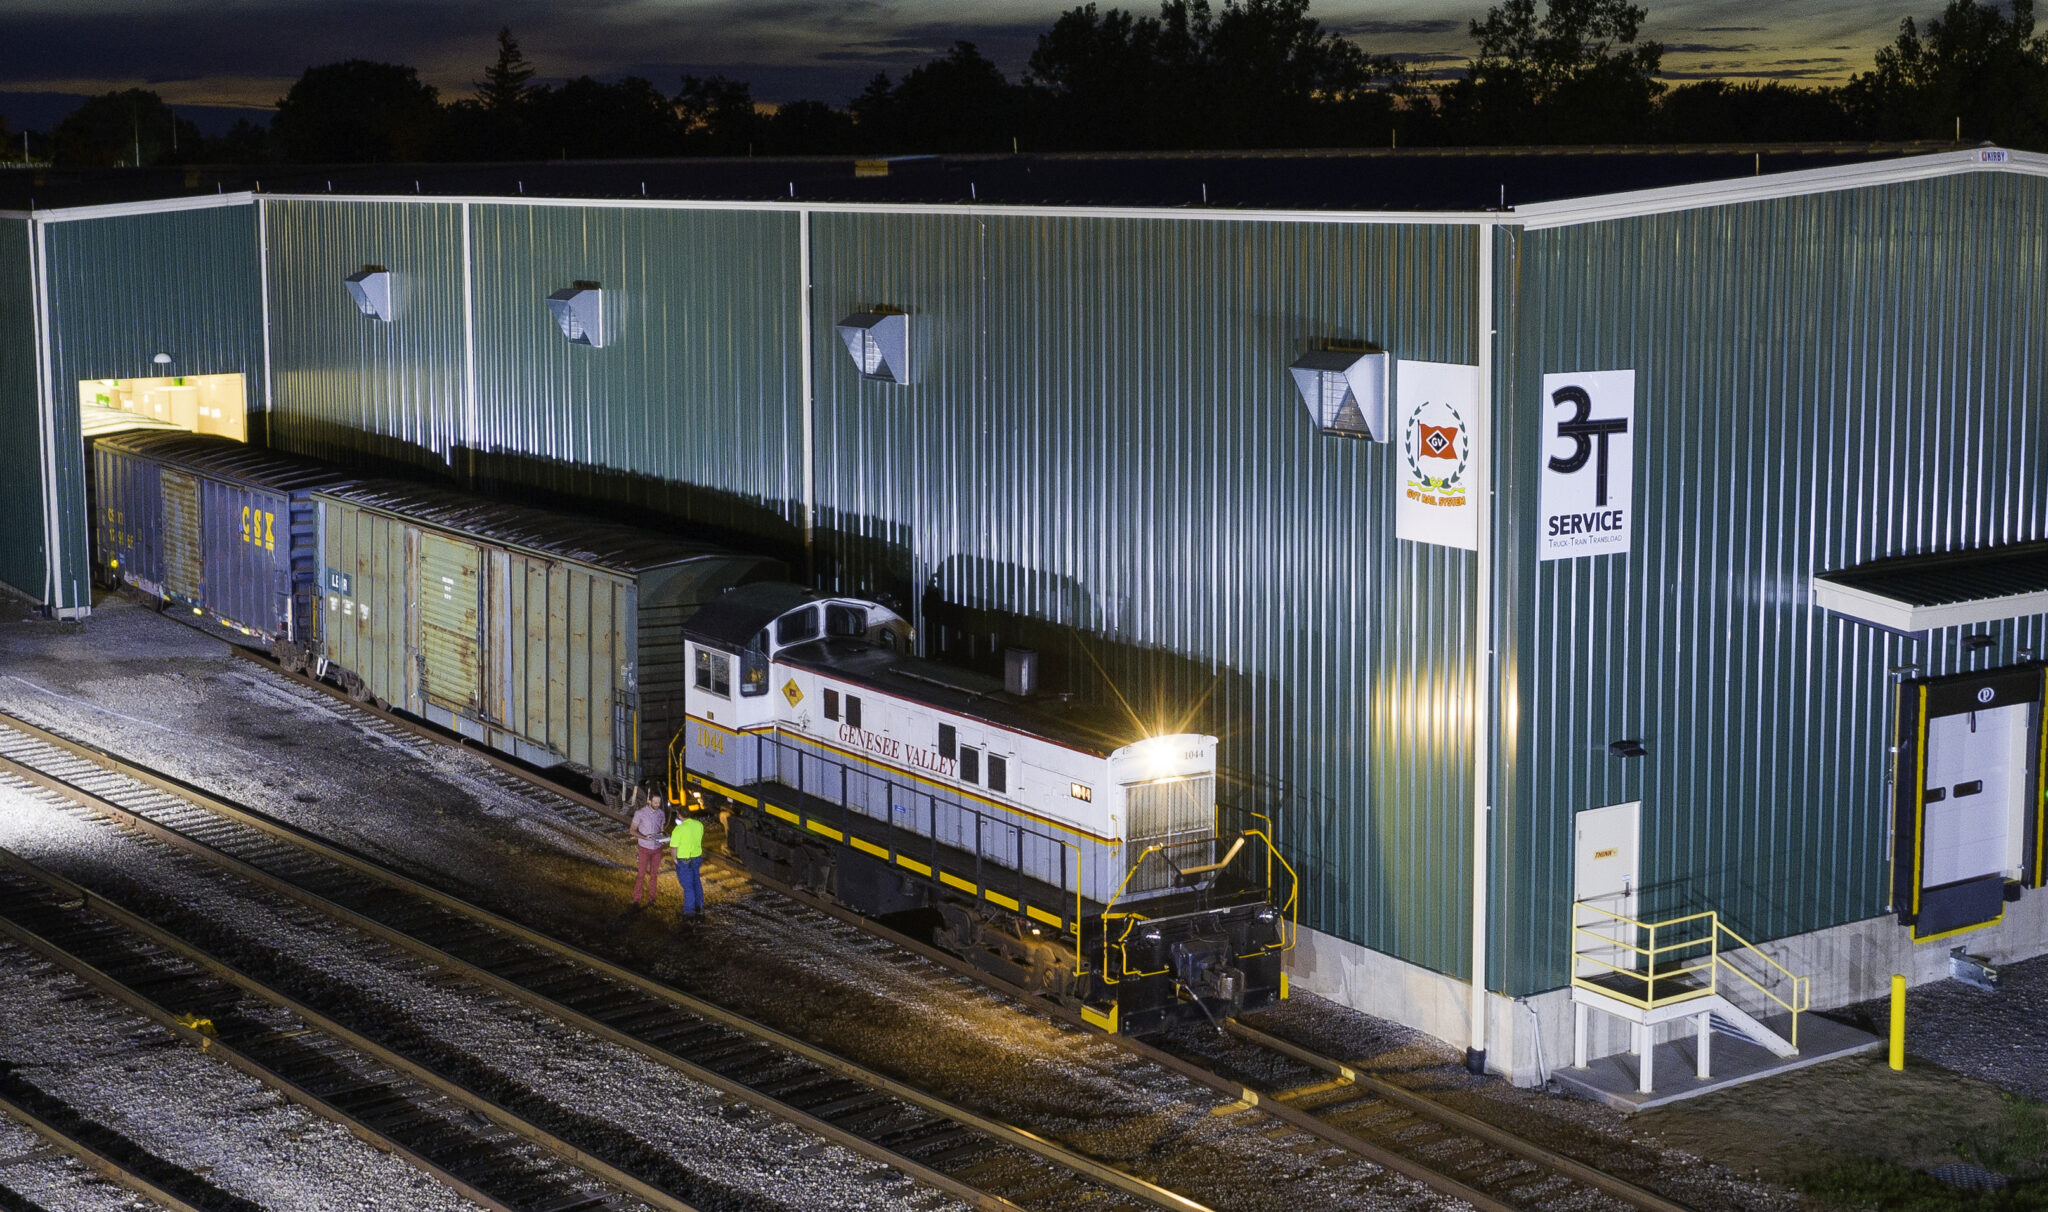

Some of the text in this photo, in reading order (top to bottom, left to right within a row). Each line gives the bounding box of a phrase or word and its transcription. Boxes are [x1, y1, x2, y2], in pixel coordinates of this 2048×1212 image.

[1431, 437, 1443, 447] GV
[1548, 386, 1628, 507] 3T
[1438, 495, 1466, 507] SYSTEM
[242, 506, 274, 546] CSX
[1548, 510, 1623, 537] SERVICE
[696, 726, 724, 755] 1044
[838, 723, 959, 777] GENESEE VALLEY
[1184, 749, 1204, 760] 1044
